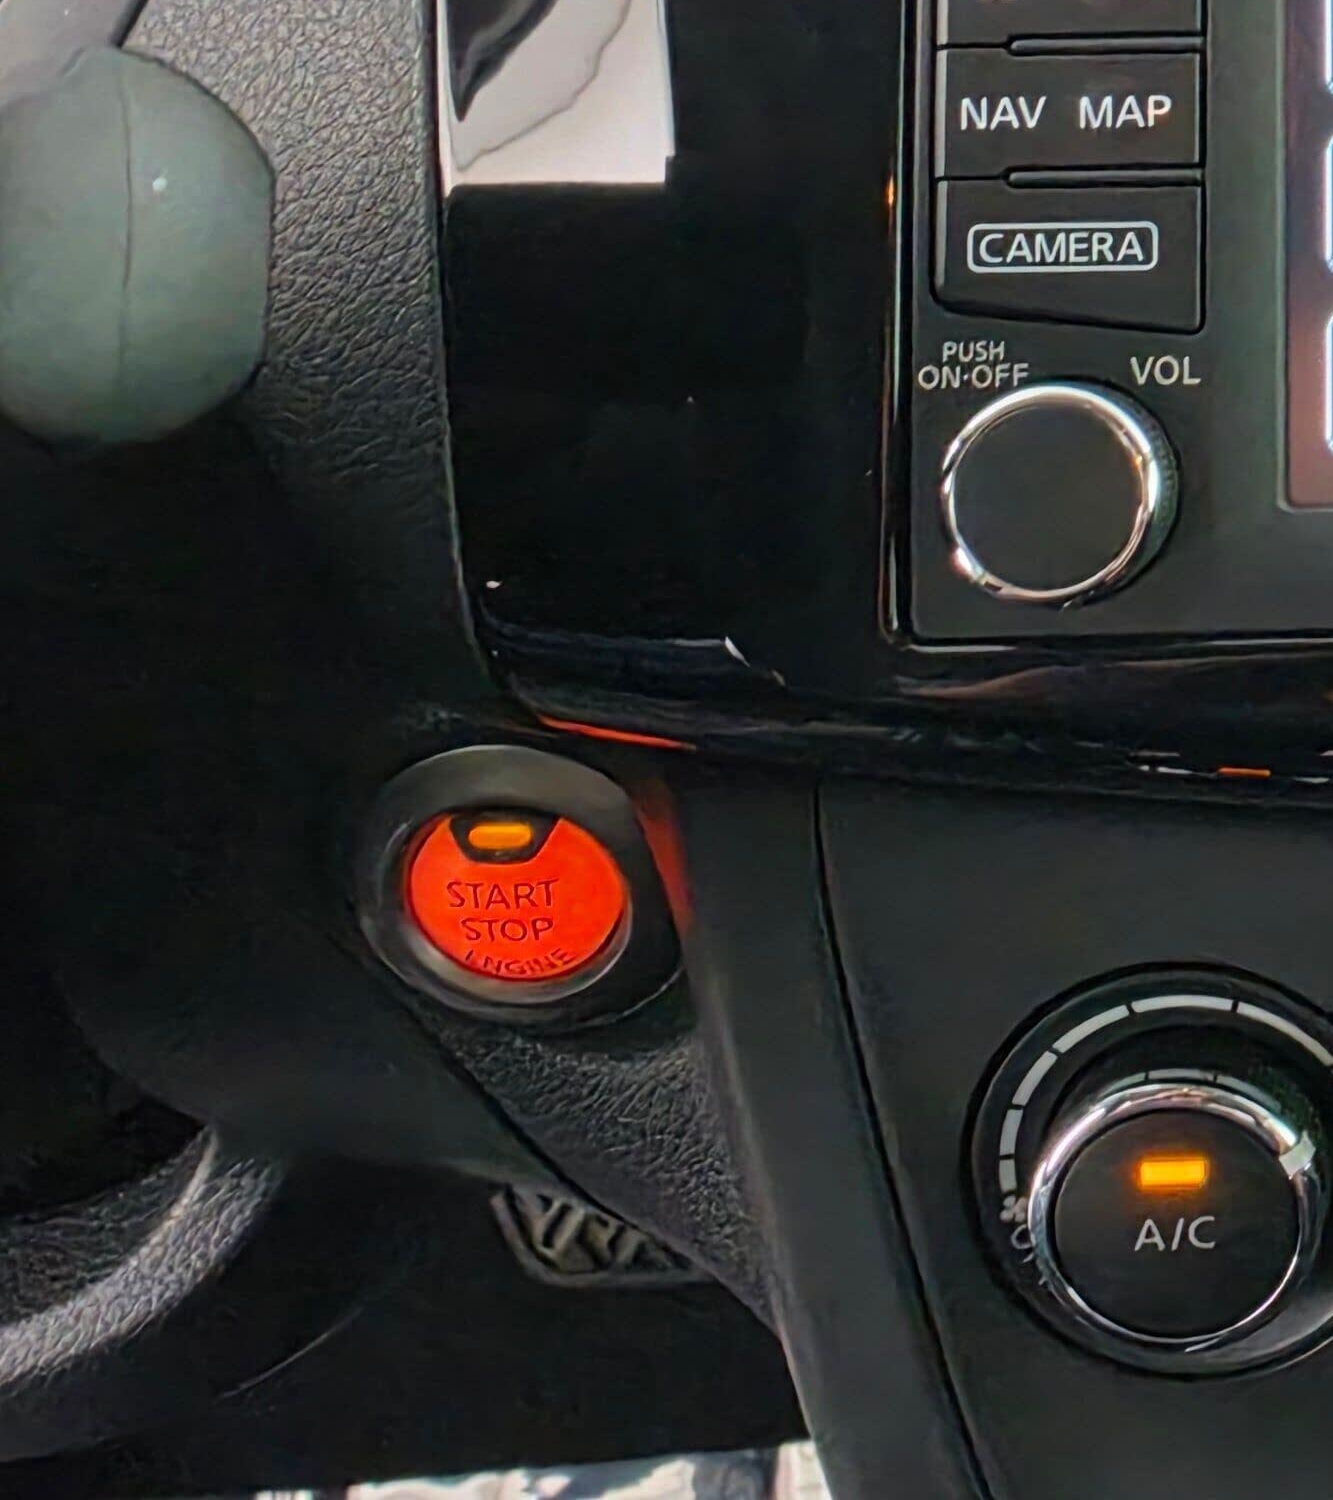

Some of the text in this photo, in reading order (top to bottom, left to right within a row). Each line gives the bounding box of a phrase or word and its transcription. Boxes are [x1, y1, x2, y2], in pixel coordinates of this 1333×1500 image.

[959, 94, 1172, 131] NAV MAP
[978, 231, 1144, 264] CAMERA
[941, 340, 1006, 363] PUSH
[1129, 355, 1202, 386] VOL
[446, 877, 560, 911] START
[460, 916, 554, 943] STOP
[1134, 1215, 1217, 1252] A/C
